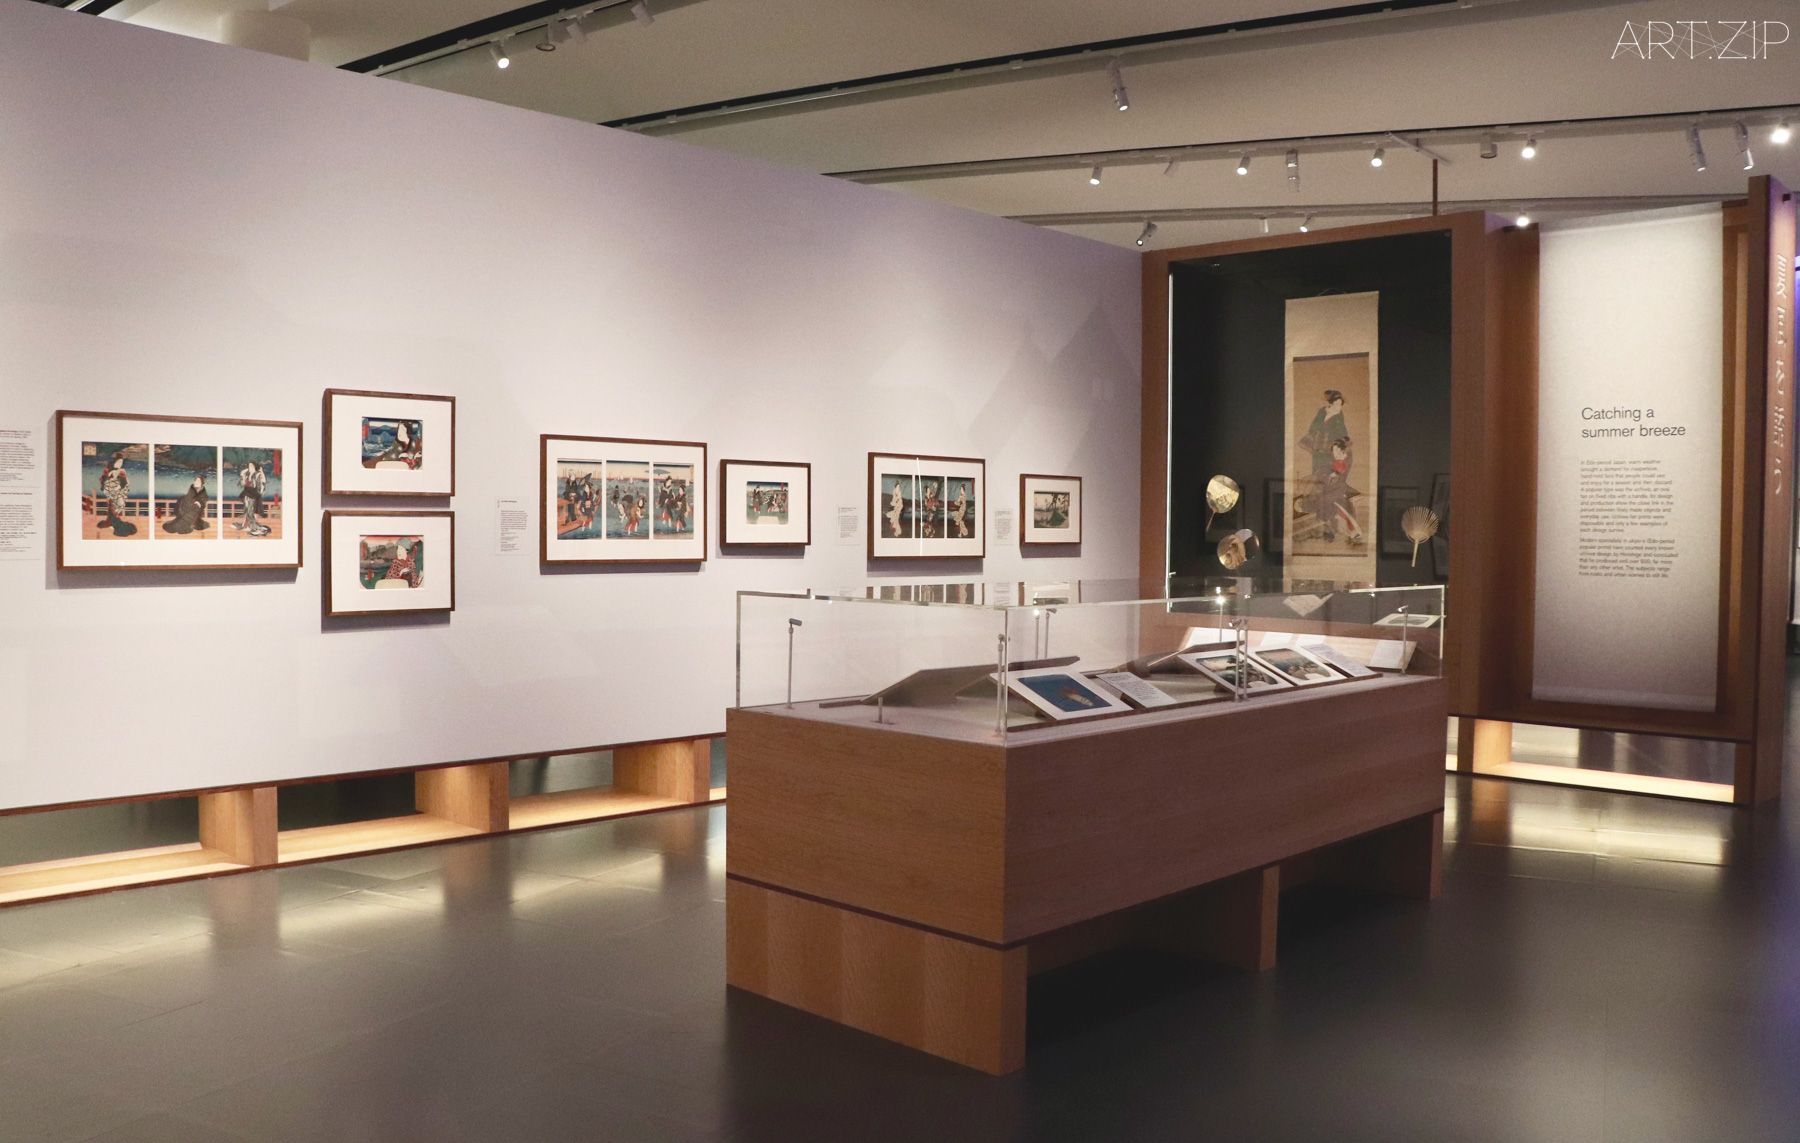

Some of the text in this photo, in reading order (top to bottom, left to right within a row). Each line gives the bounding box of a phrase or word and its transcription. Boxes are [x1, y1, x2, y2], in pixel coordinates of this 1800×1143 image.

[1581, 406, 1655, 422] Catching a
[1581, 424, 1686, 438] summer breeze
